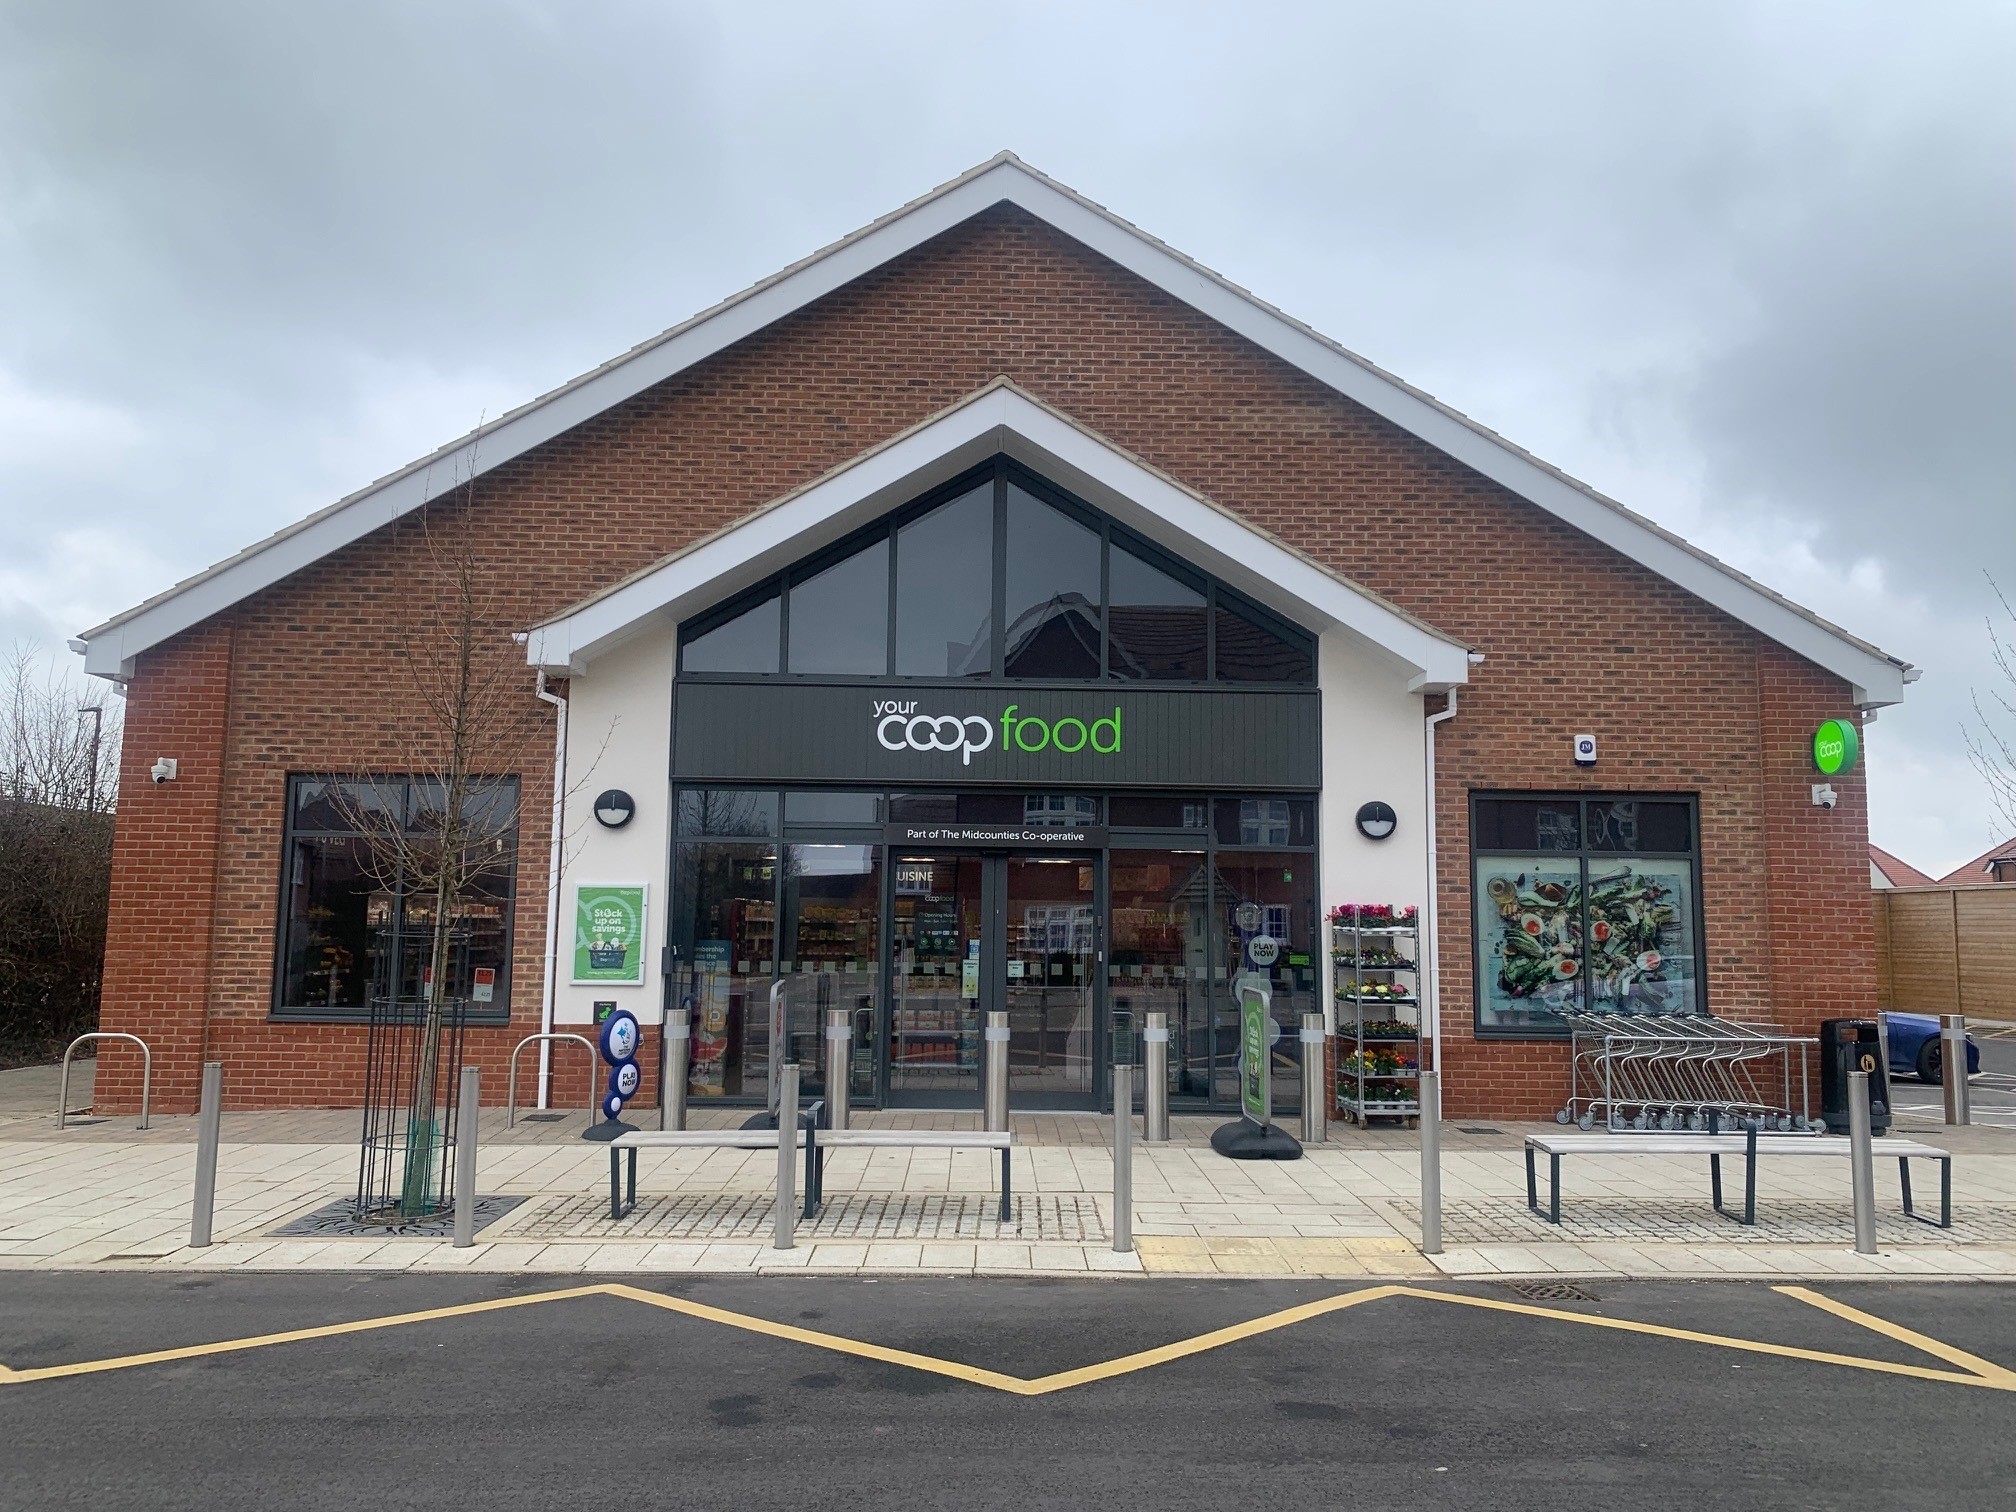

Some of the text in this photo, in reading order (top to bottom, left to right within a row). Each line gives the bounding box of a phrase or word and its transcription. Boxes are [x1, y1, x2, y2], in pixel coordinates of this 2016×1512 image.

[873, 700, 918, 717] your
[877, 705, 1121, 765] coop food
[907, 829, 1085, 842] Part of The Midcounties Co-operative
[896, 871, 933, 882] UISINE
[594, 908, 623, 918] Stock
[594, 918, 607, 926] up
[591, 925, 626, 935] savings
